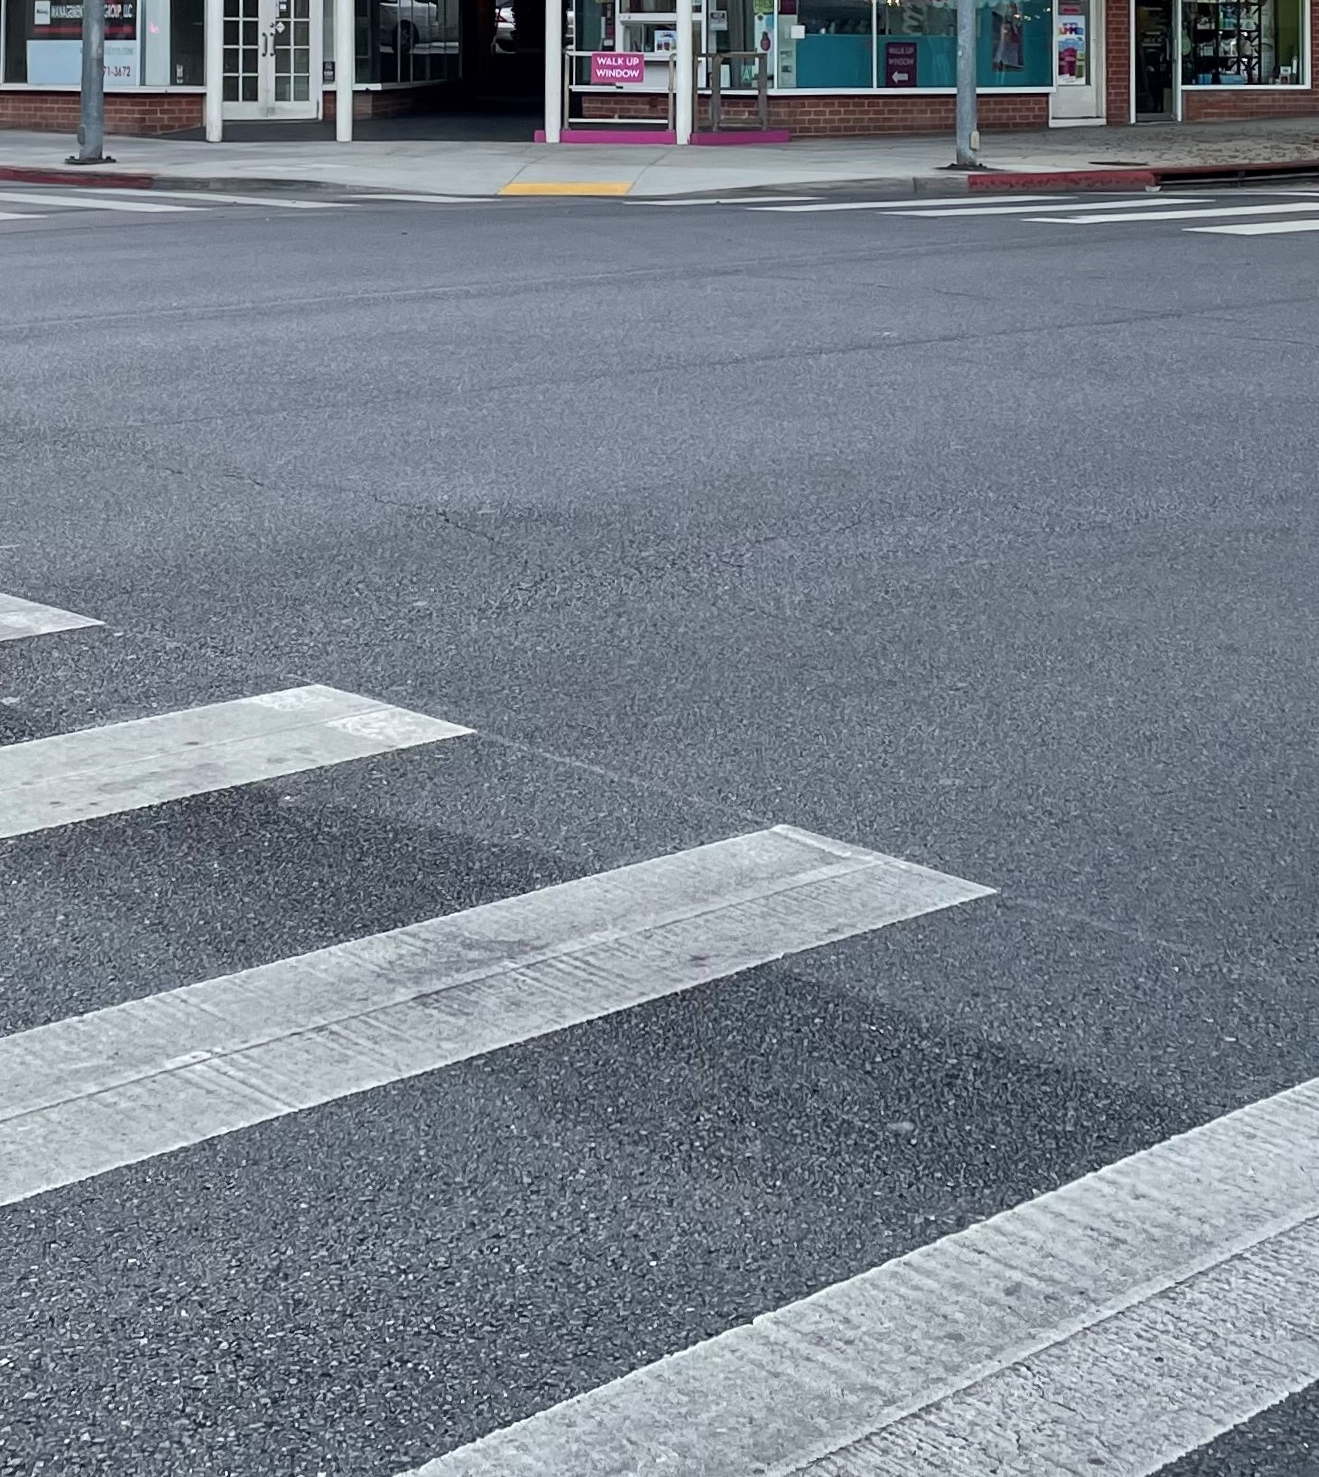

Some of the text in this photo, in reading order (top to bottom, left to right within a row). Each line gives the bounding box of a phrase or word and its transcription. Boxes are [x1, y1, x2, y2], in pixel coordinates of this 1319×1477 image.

[123, 4, 133, 18] LLC
[596, 56, 640, 66] WALK UP
[595, 68, 640, 78] WINDOW
